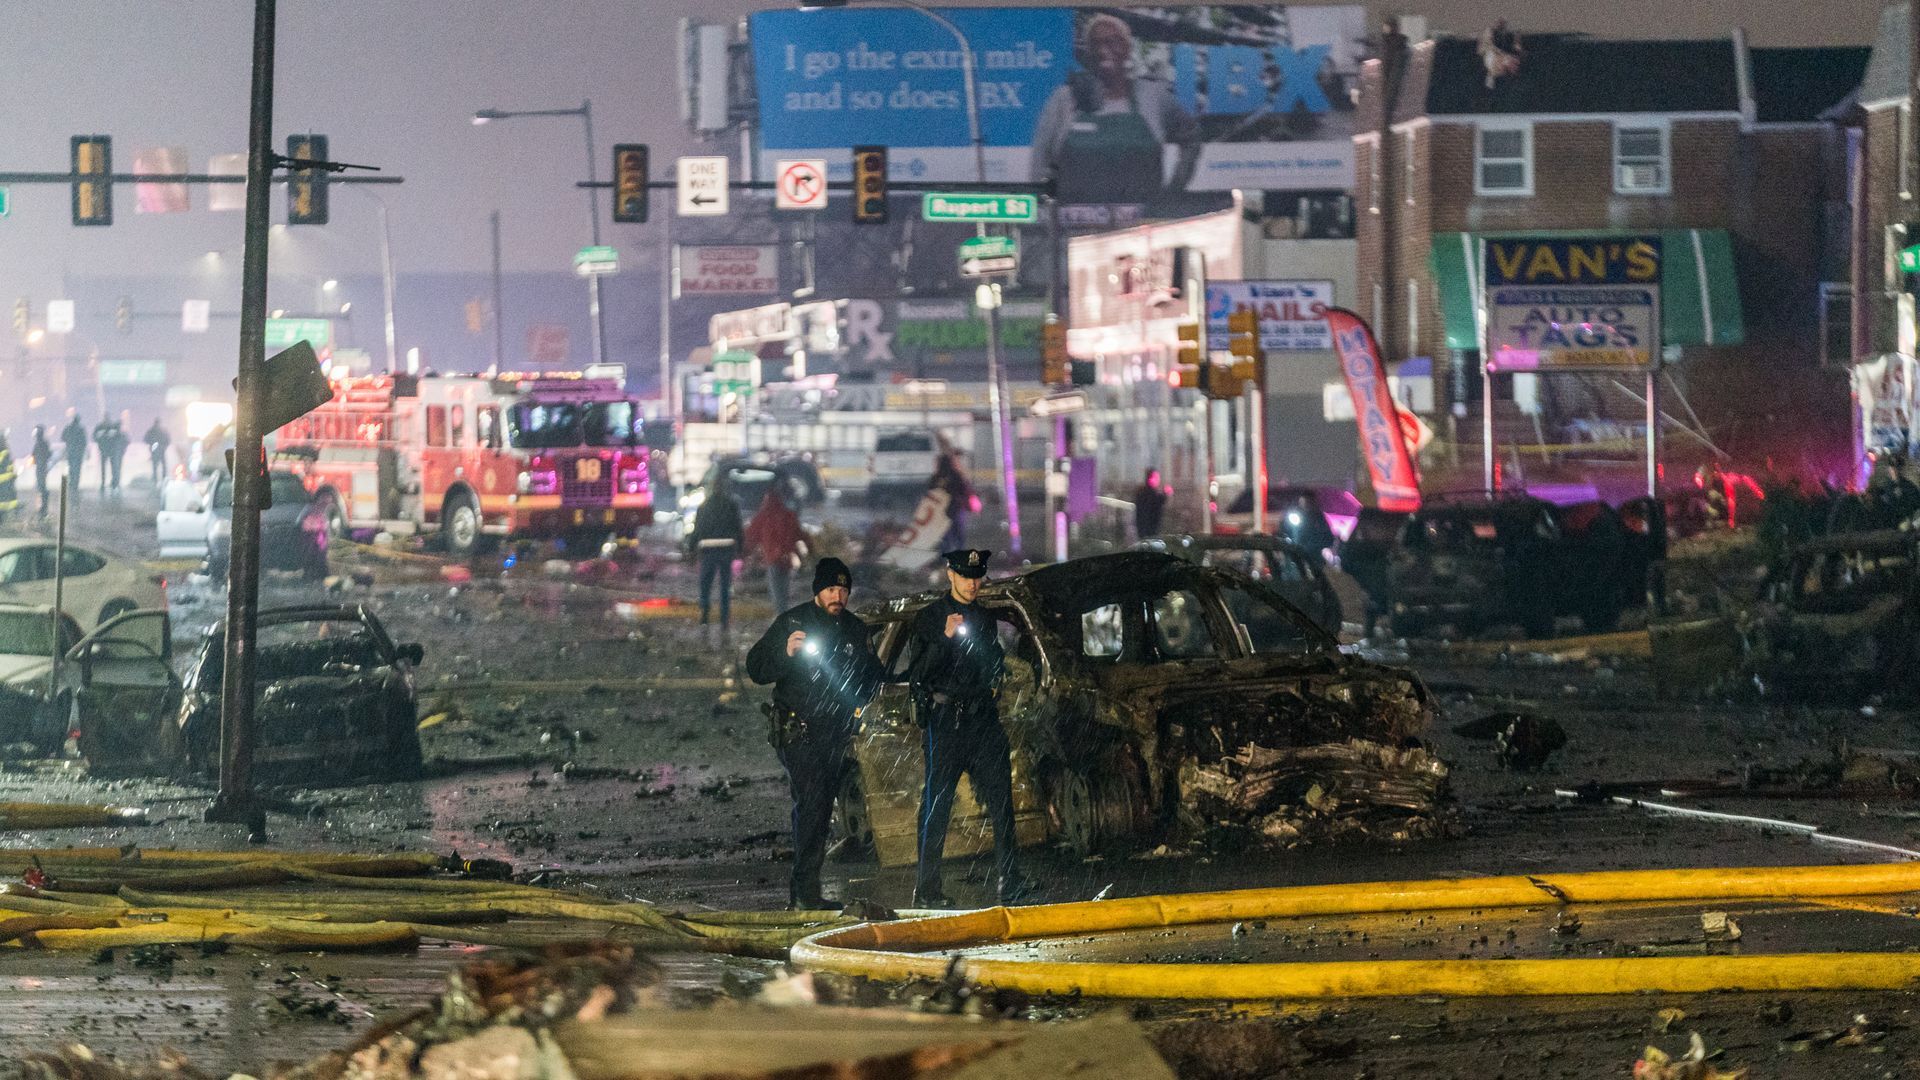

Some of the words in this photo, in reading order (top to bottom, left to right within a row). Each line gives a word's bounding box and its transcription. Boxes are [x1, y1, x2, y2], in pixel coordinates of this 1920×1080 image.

[785, 44, 796, 71] I
[803, 51, 841, 80] go
[846, 42, 896, 69] the
[985, 41, 1052, 69] mile
[1174, 42, 1333, 115] IBX
[784, 81, 842, 109] and
[850, 90, 884, 109] so
[889, 80, 960, 109] does
[968, 82, 1024, 108] BX
[690, 162, 718, 176] ONE
[689, 179, 719, 191] WAY
[931, 198, 999, 218] Rupert
[1005, 198, 1029, 216] St
[700, 262, 758, 276] FOOD
[1493, 242, 1660, 281] VAN'S
[682, 279, 778, 292] MARKET
[1523, 307, 1625, 323] AUTO
[1508, 323, 1640, 348] TAGS
[1338, 325, 1394, 481] NOTARY
